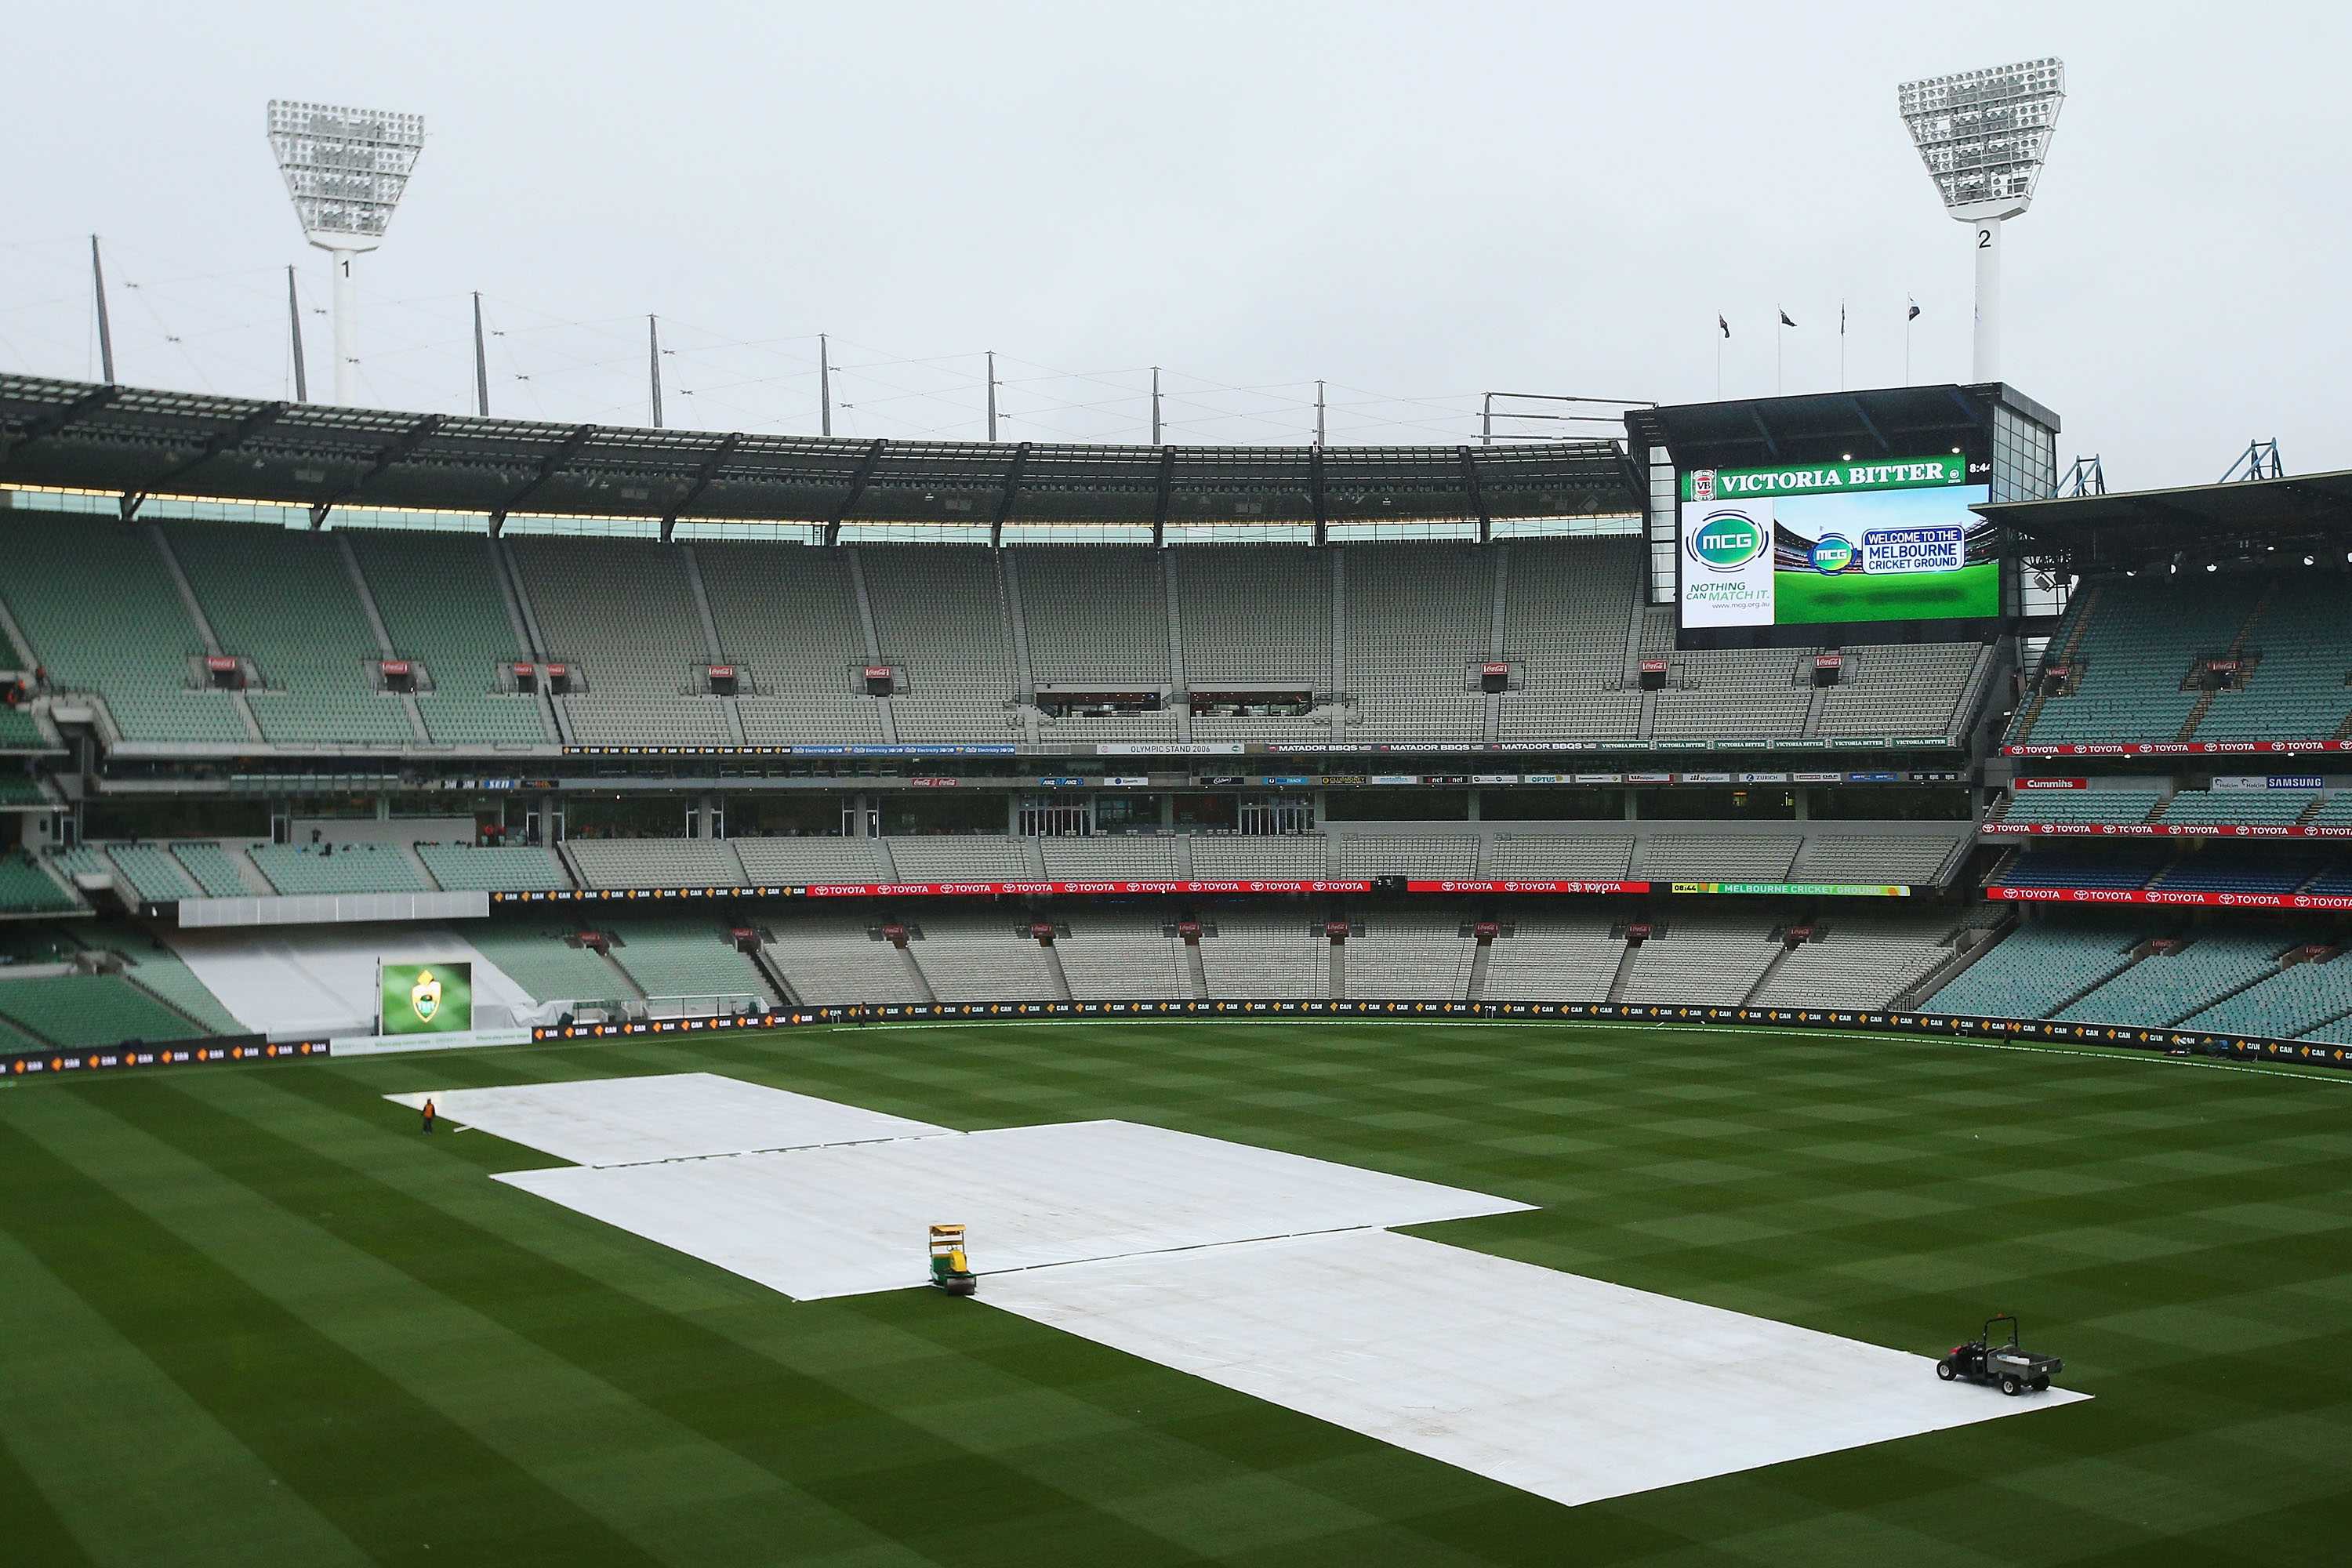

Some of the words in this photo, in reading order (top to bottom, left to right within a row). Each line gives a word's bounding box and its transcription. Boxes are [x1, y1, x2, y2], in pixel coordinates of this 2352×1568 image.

[1978, 230, 1991, 249] 2
[342, 260, 349, 278] 1
[1721, 470, 1842, 492] VICTORIA
[1848, 463, 1944, 485] BITTER
[1702, 533, 1751, 550] MCG
[1867, 532, 1922, 545] WELCOME
[1922, 531, 1936, 542] TO
[1936, 530, 1958, 541] THE
[1816, 549, 1847, 561] MCG
[1869, 543, 1957, 559] MELBOURNE
[1868, 559, 1912, 570] CRICKET
[1914, 557, 1957, 568] GROUND
[1690, 582, 1746, 593] NOTHING
[1708, 590, 1753, 601] MATCH
[1755, 590, 1769, 599] IT.
[2027, 779, 2074, 788] Cummins
[2269, 778, 2321, 787] SAMSUNG
[2252, 826, 2288, 835] TOYOTA
[2020, 890, 2060, 898] TOYOTA
[2162, 894, 2205, 902] TOYOTA
[2236, 896, 2280, 905] TOYOTA
[2247, 1042, 2259, 1051] CAN
